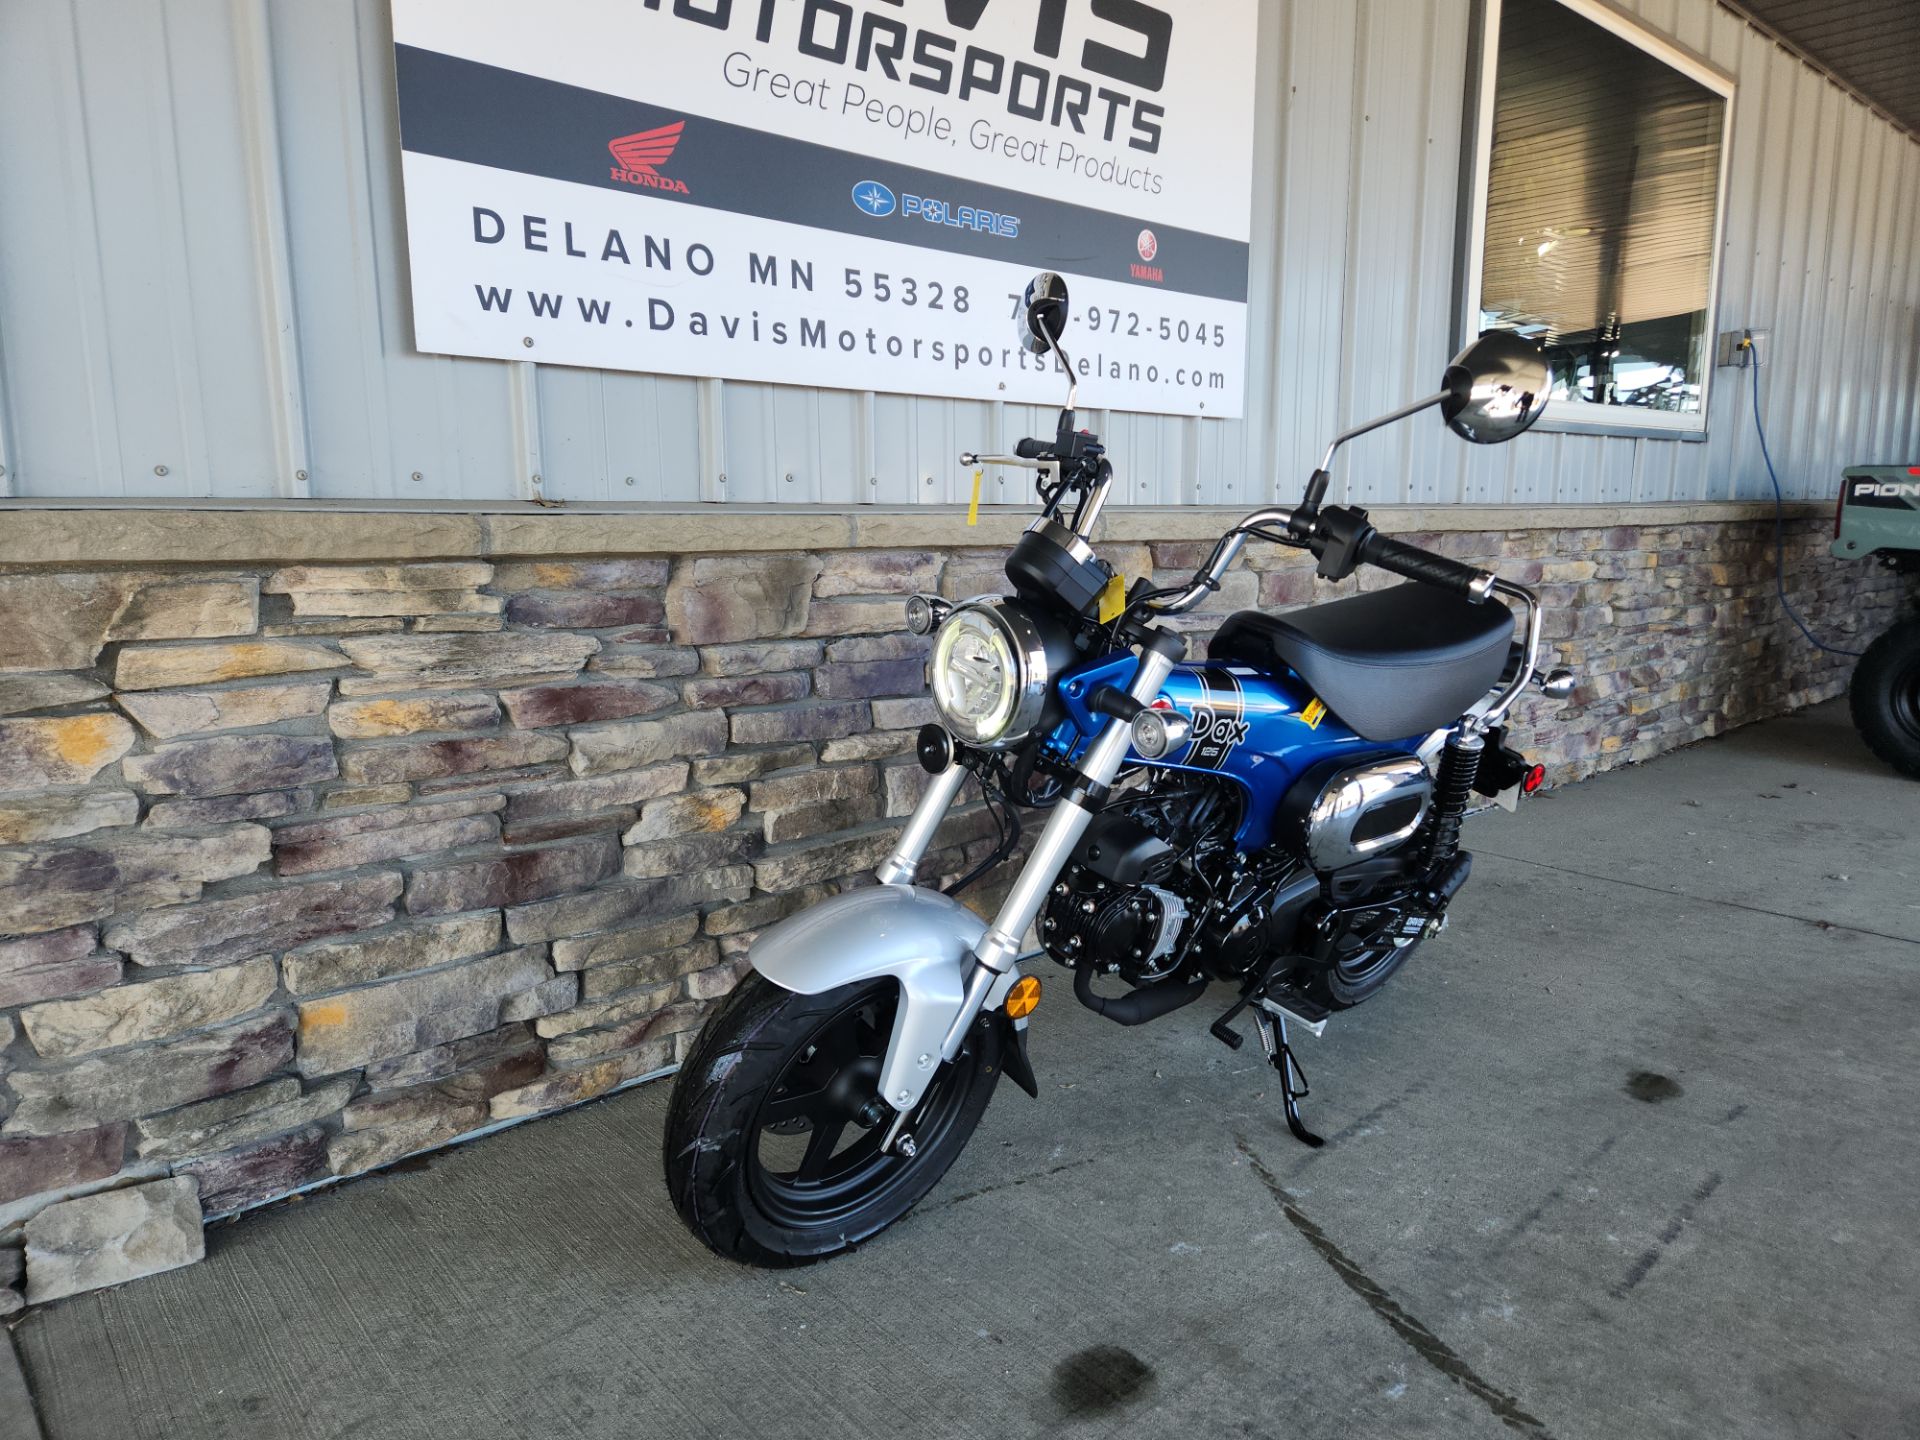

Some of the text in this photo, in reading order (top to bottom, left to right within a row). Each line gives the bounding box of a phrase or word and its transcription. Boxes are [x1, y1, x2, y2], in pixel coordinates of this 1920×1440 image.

[644, 0, 1165, 155] ORSPORTS
[723, 51, 1163, 195] Great People, Great Products
[610, 167, 690, 194] HONDA
[902, 193, 1019, 238] POLARIS
[472, 206, 1224, 347] DELANO MN 55328 7-972-5045
[1130, 263, 1164, 283] YAMAHA
[1189, 703, 1250, 746] Dax
[1200, 747, 1220, 757] 125
